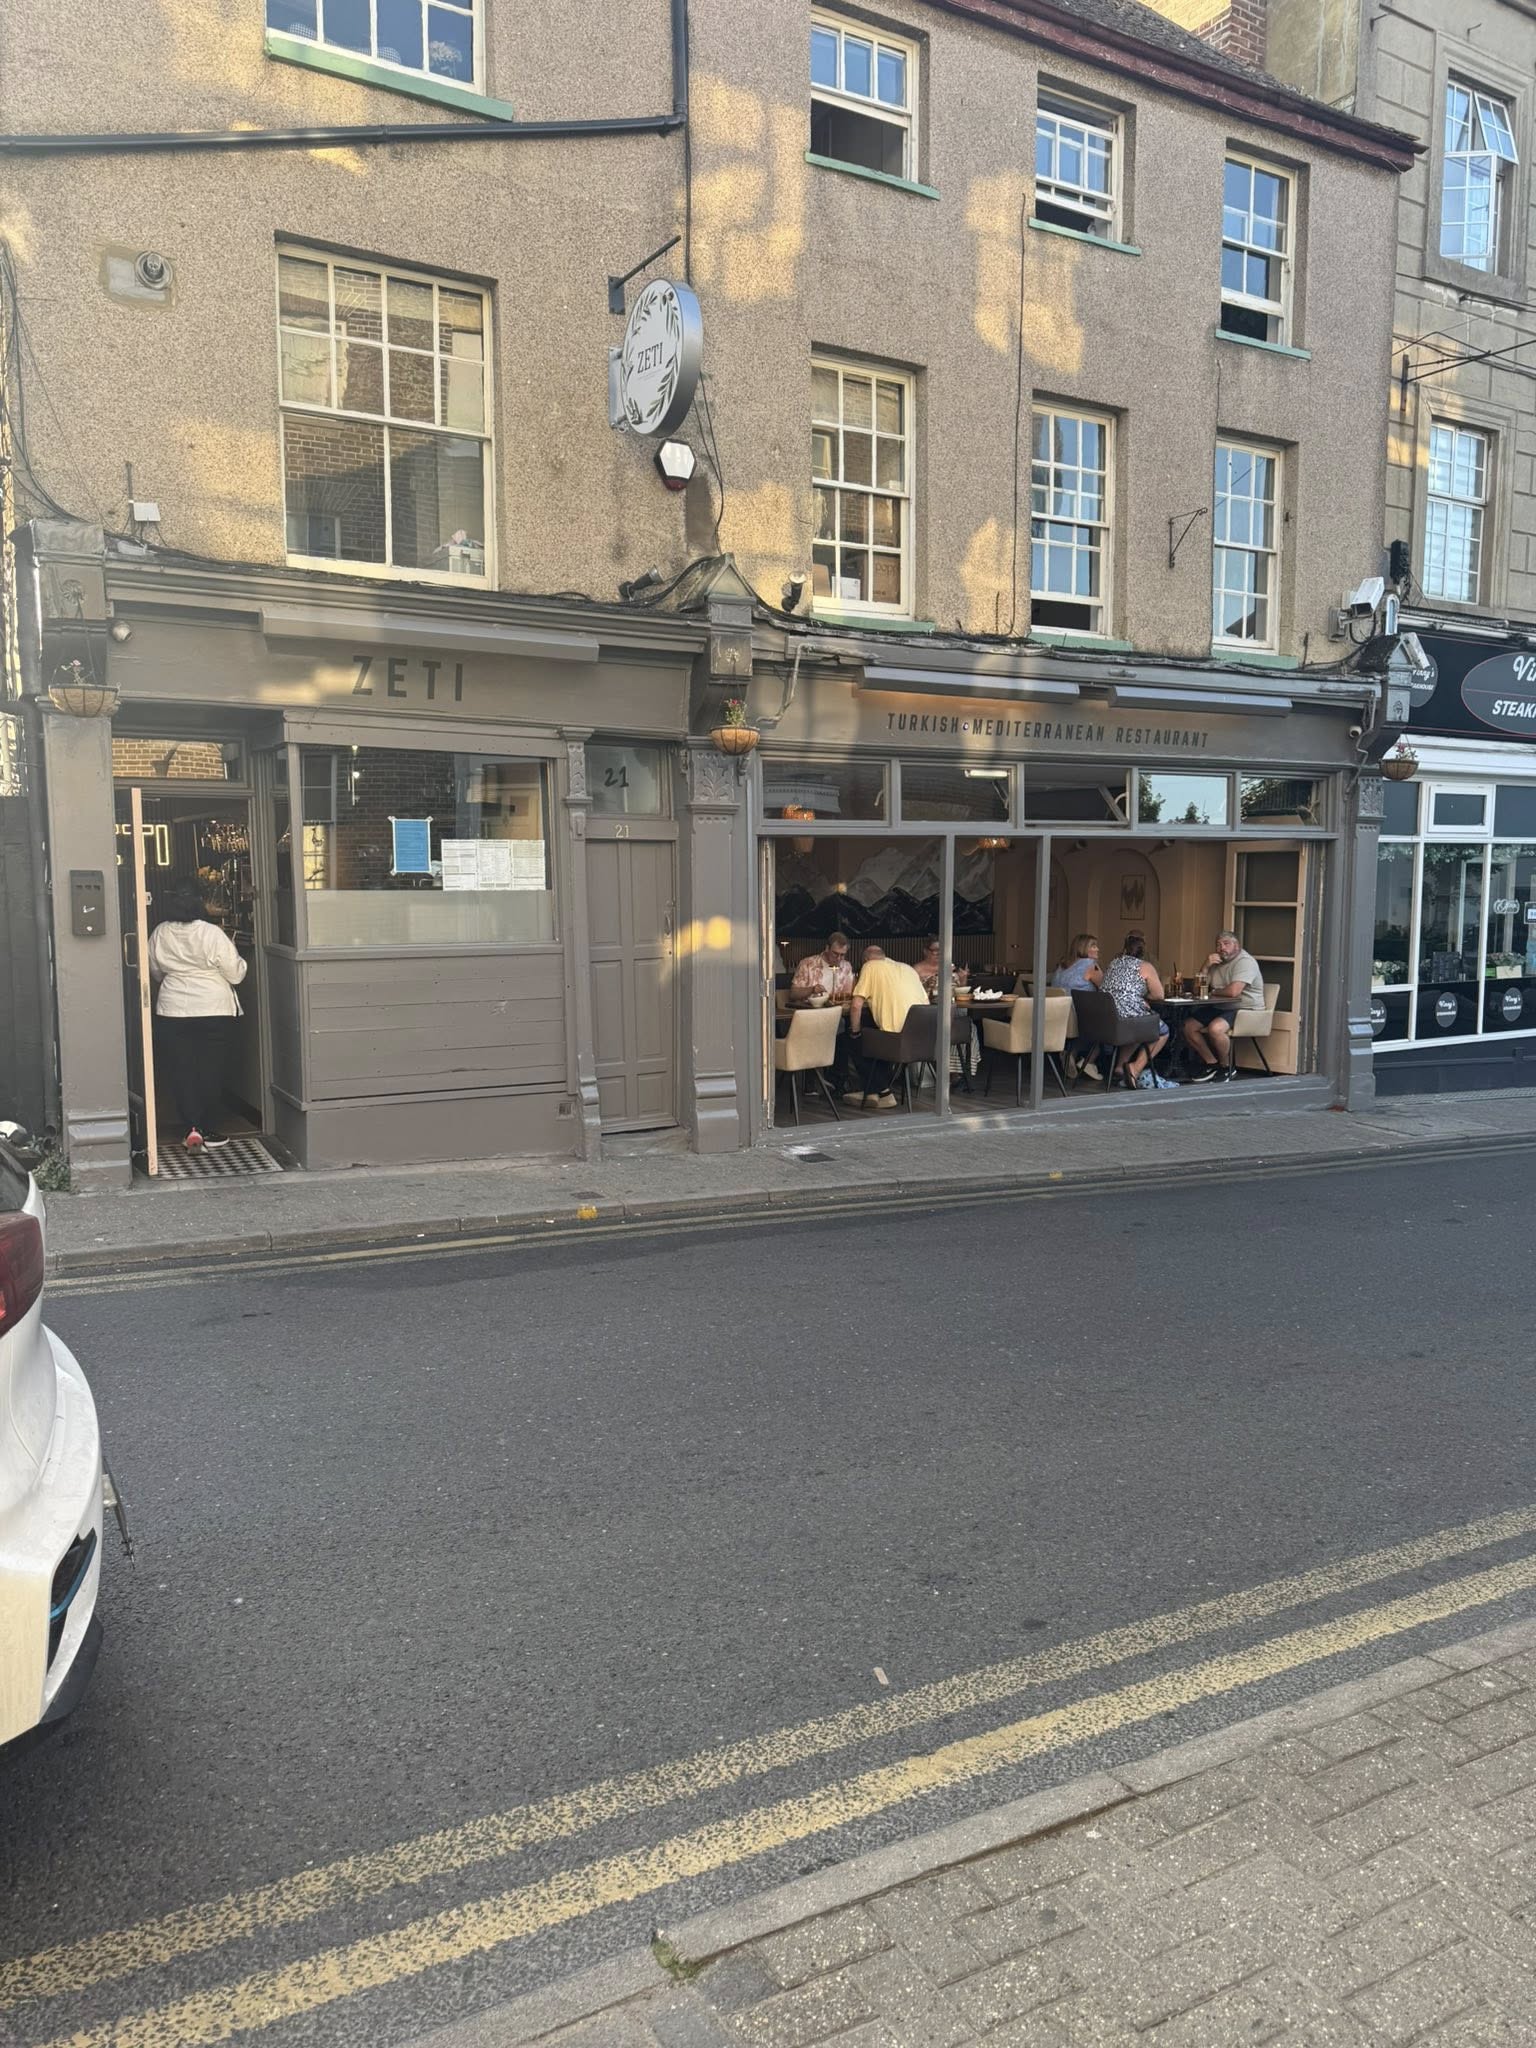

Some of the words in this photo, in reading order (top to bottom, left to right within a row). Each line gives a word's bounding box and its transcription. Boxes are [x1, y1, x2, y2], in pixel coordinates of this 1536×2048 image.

[637, 342, 663, 373] ZETI
[352, 655, 463, 701] ZETI
[1513, 655, 1536, 681] Vi
[887, 713, 959, 734] TURKISH
[972, 718, 1104, 742] MEDITERRANEAN
[1116, 727, 1208, 748] RESTAURANT
[604, 766, 629, 788] 21
[615, 823, 629, 838] 21
